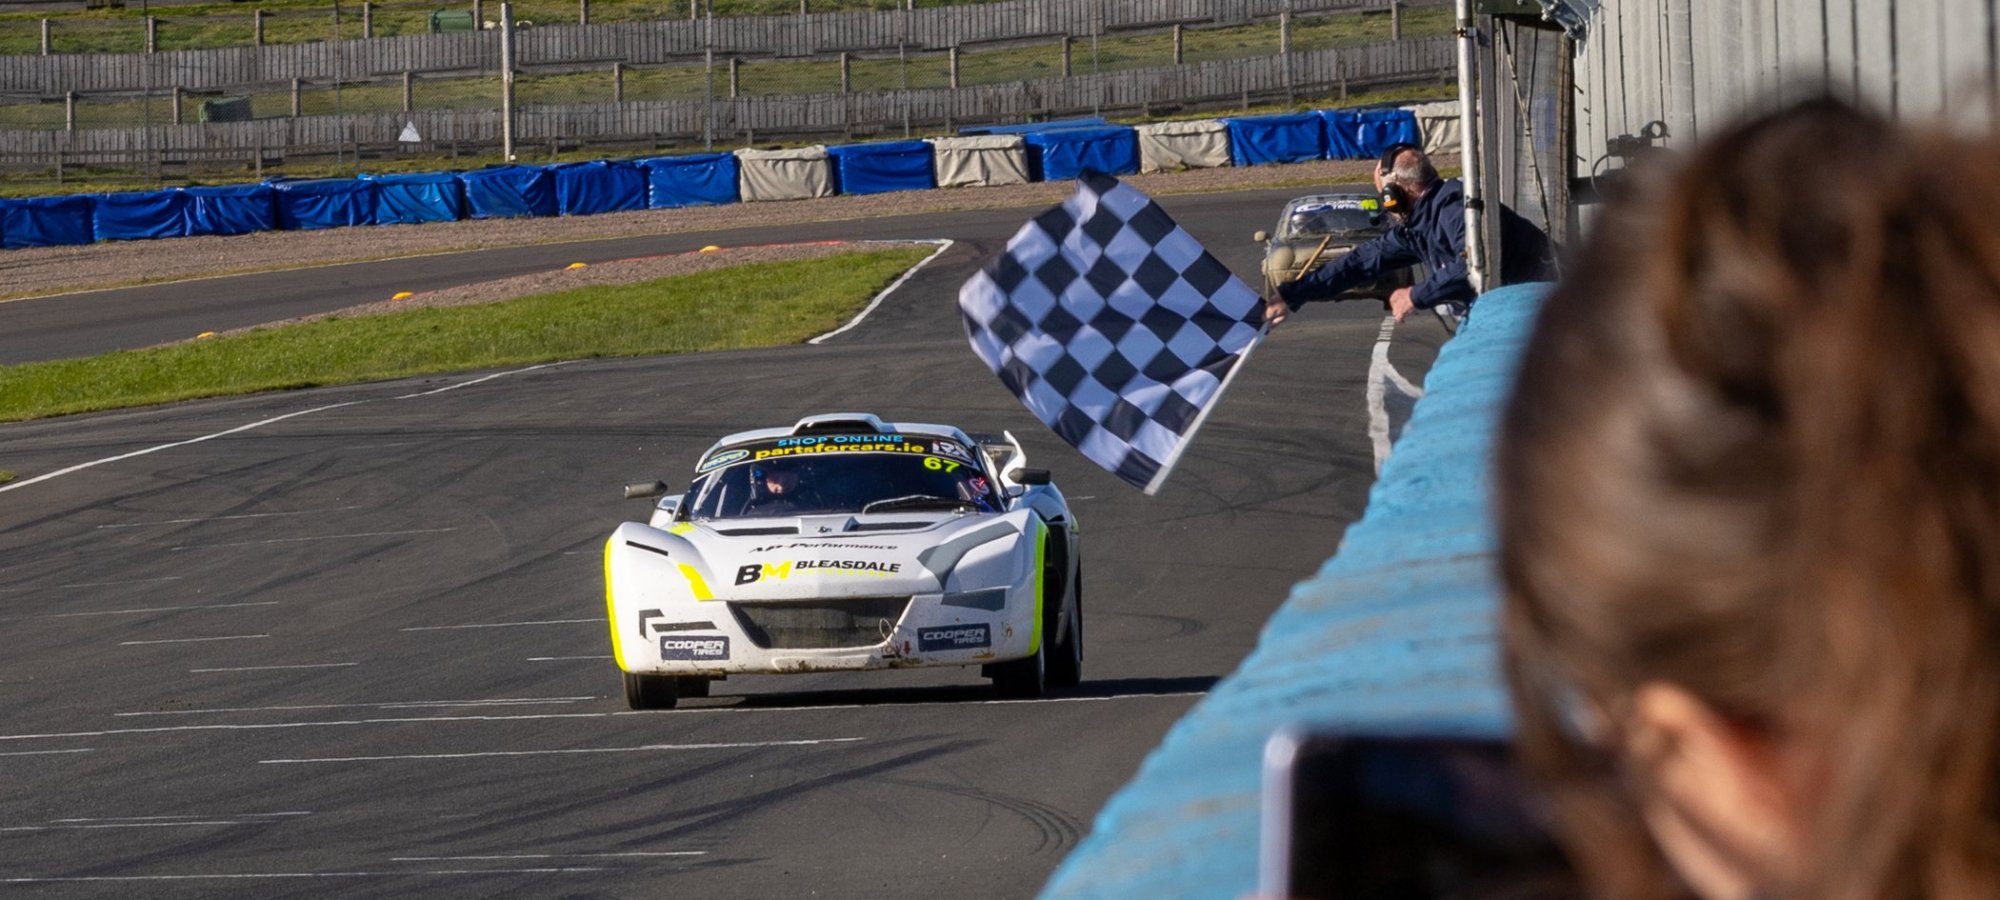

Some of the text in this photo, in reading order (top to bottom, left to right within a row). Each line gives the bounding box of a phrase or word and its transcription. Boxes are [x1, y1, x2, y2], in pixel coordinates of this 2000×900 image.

[778, 435, 903, 446] SHOP ONLINE
[755, 443, 925, 459] partsforcars.ie
[923, 456, 960, 473] 67
[795, 560, 901, 573] BLEASDALE
[735, 560, 793, 586] BM
[922, 628, 985, 640] COOPER
[665, 641, 725, 649] COOPER
[692, 648, 724, 656] TIRES
